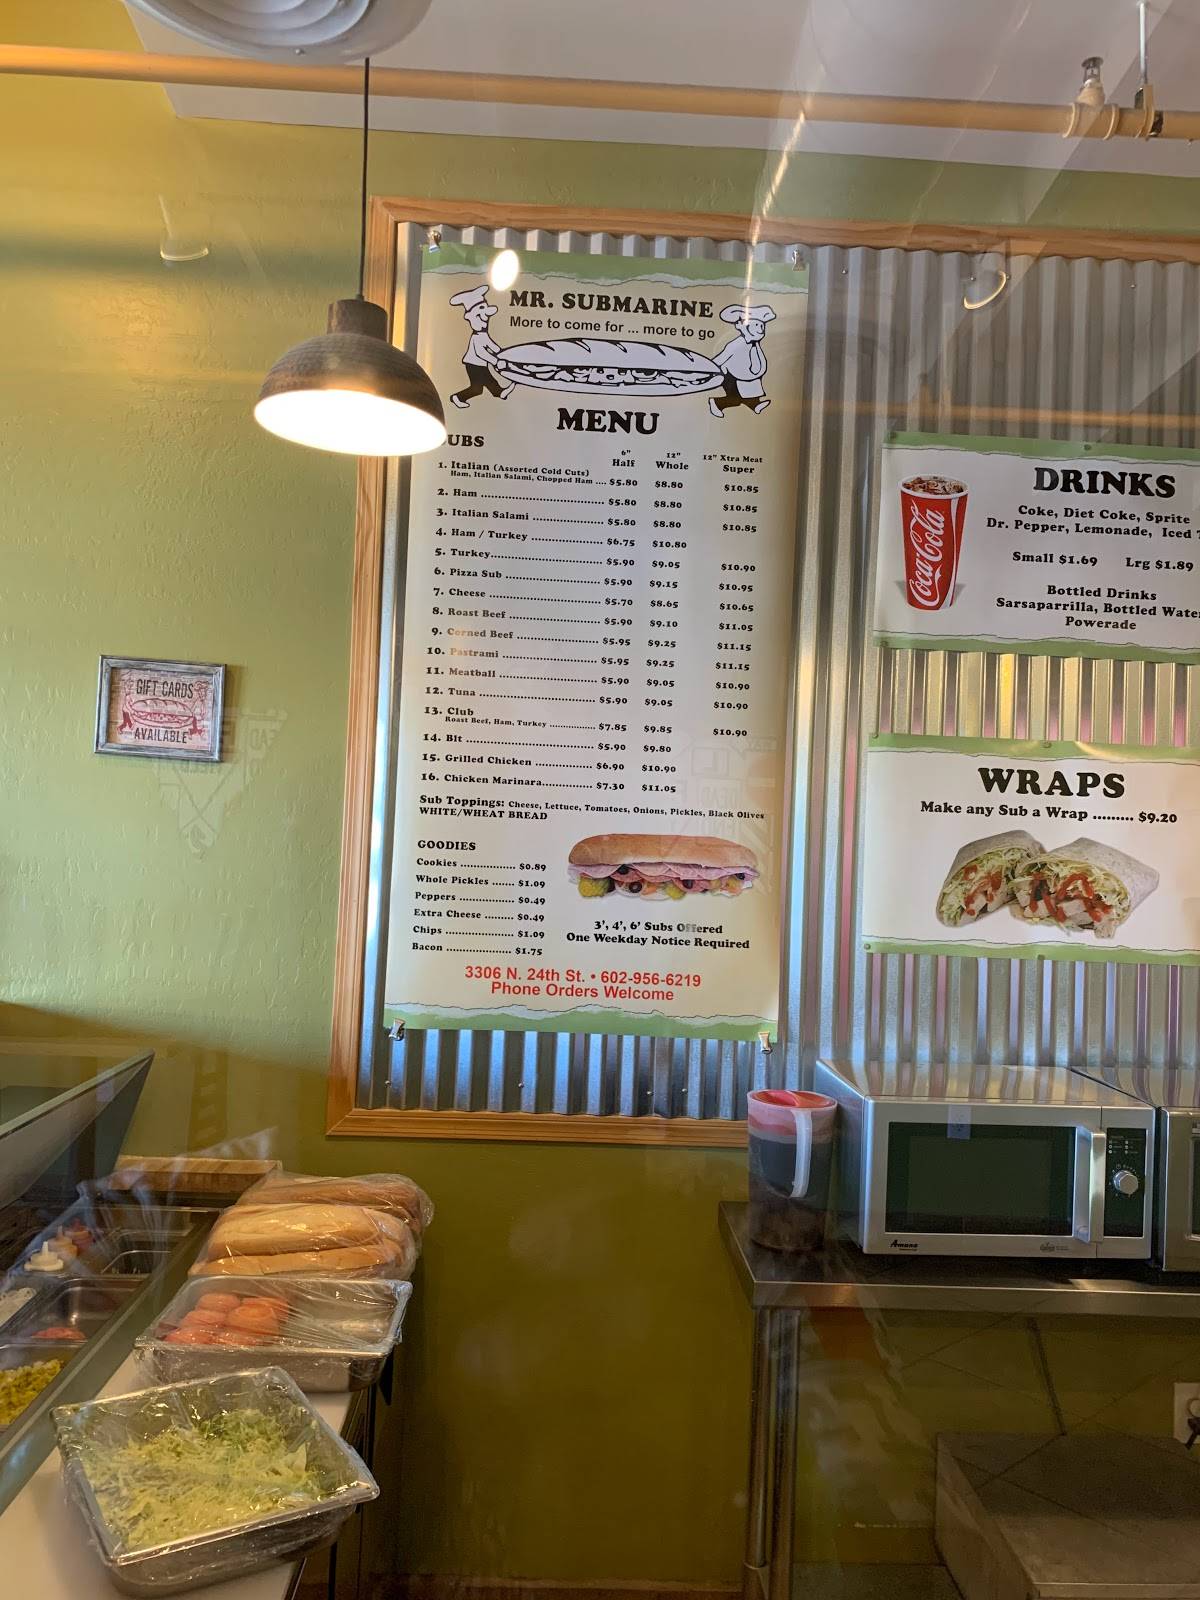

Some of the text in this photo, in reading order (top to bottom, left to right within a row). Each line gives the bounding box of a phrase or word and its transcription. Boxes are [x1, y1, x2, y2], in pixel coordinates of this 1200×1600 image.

[509, 290, 713, 318] MR. SUBMARINE
[510, 316, 715, 340] More to come for more to go
[557, 408, 659, 434] MENU
[451, 461, 489, 470] Italian
[494, 464, 538, 473] (Assorted
[565, 469, 589, 477] Cuts)
[613, 459, 635, 467] Half
[656, 461, 688, 470] Whole
[723, 465, 754, 474] Super
[724, 484, 758, 493] $10.85
[1033, 467, 1175, 498] DRINKS
[453, 489, 477, 497] Ham
[609, 498, 636, 506] $5.80
[723, 504, 757, 513] $10.85
[453, 509, 756, 533] Italian Salami $5.80 $8.80 $10.85
[1019, 505, 1190, 524] Coke, Diet Coke, Sprite
[987, 518, 1008, 528] Dr.
[1015, 520, 1069, 534] Pepper,
[1075, 523, 1152, 538] Lemonade,
[1162, 528, 1191, 538] Iced
[452, 529, 686, 548] Ham Turkey $6.75 $10.80
[451, 549, 490, 559] Turkey
[607, 558, 634, 566] $5.90
[721, 564, 755, 572] $10.90
[1013, 552, 1097, 566] Small $1.69
[1126, 557, 1193, 571] Lrg $1.89
[450, 568, 752, 592] Pizza Sub $5.90 $9.15 $10.95
[449, 588, 753, 612] Cheese $5.70 $8.65 $10.65
[1048, 585, 1156, 600] Bottled Drinks
[997, 598, 1156, 615] Sarsaparrilla, Bottled
[448, 608, 478, 616] Roast
[483, 610, 506, 618] Beef
[604, 617, 632, 626] $5.90
[719, 623, 753, 631] $11.05
[1065, 616, 1136, 629] Powerade
[490, 630, 751, 651] Beef $5.95 $9.25 $11.15
[601, 657, 749, 671] $5.95 $9.25 $11.15
[449, 668, 749, 690] Meatball $5.90 $9.05 $10.90
[136, 678, 194, 698] GIFT CARDS
[448, 688, 748, 710] Tuna $5.90 $9.05 $10.90
[447, 707, 473, 715] Club
[134, 727, 189, 743] AVAILABLE
[599, 723, 747, 736] $7.85 $9.85 $10.90
[446, 734, 462, 742] Blt
[598, 743, 625, 751] $5.90
[445, 754, 676, 773] Grilled Chicken $6.90 $10.90
[444, 774, 675, 792] Chicken Marinara $7.30 $11.05
[978, 768, 1124, 798] WRAPS
[420, 795, 667, 815] Sub Toppings: Cheese, Lettuce, Tomatoes, Onions,
[420, 807, 547, 819] WHITE/WHEAT BREAD
[921, 801, 1177, 823] Make any Sub a Wrap $9.20
[418, 840, 475, 850] GOODIES
[417, 858, 546, 871] Cookies $0.89
[416, 875, 545, 888] Whole Pickles $1.09
[416, 892, 545, 905] Peppers $0.49
[414, 909, 544, 922] Extra Cheese $0.49
[413, 926, 544, 939] Chips $1.09
[644, 922, 672, 931] Subs
[412, 943, 542, 955] Bacon $1.75
[567, 933, 749, 949] One Weekday Notice Required
[465, 966, 700, 987] 3306 N. 24th St. 602-956-6219
[492, 981, 673, 1000] Phone Orders Welcome
